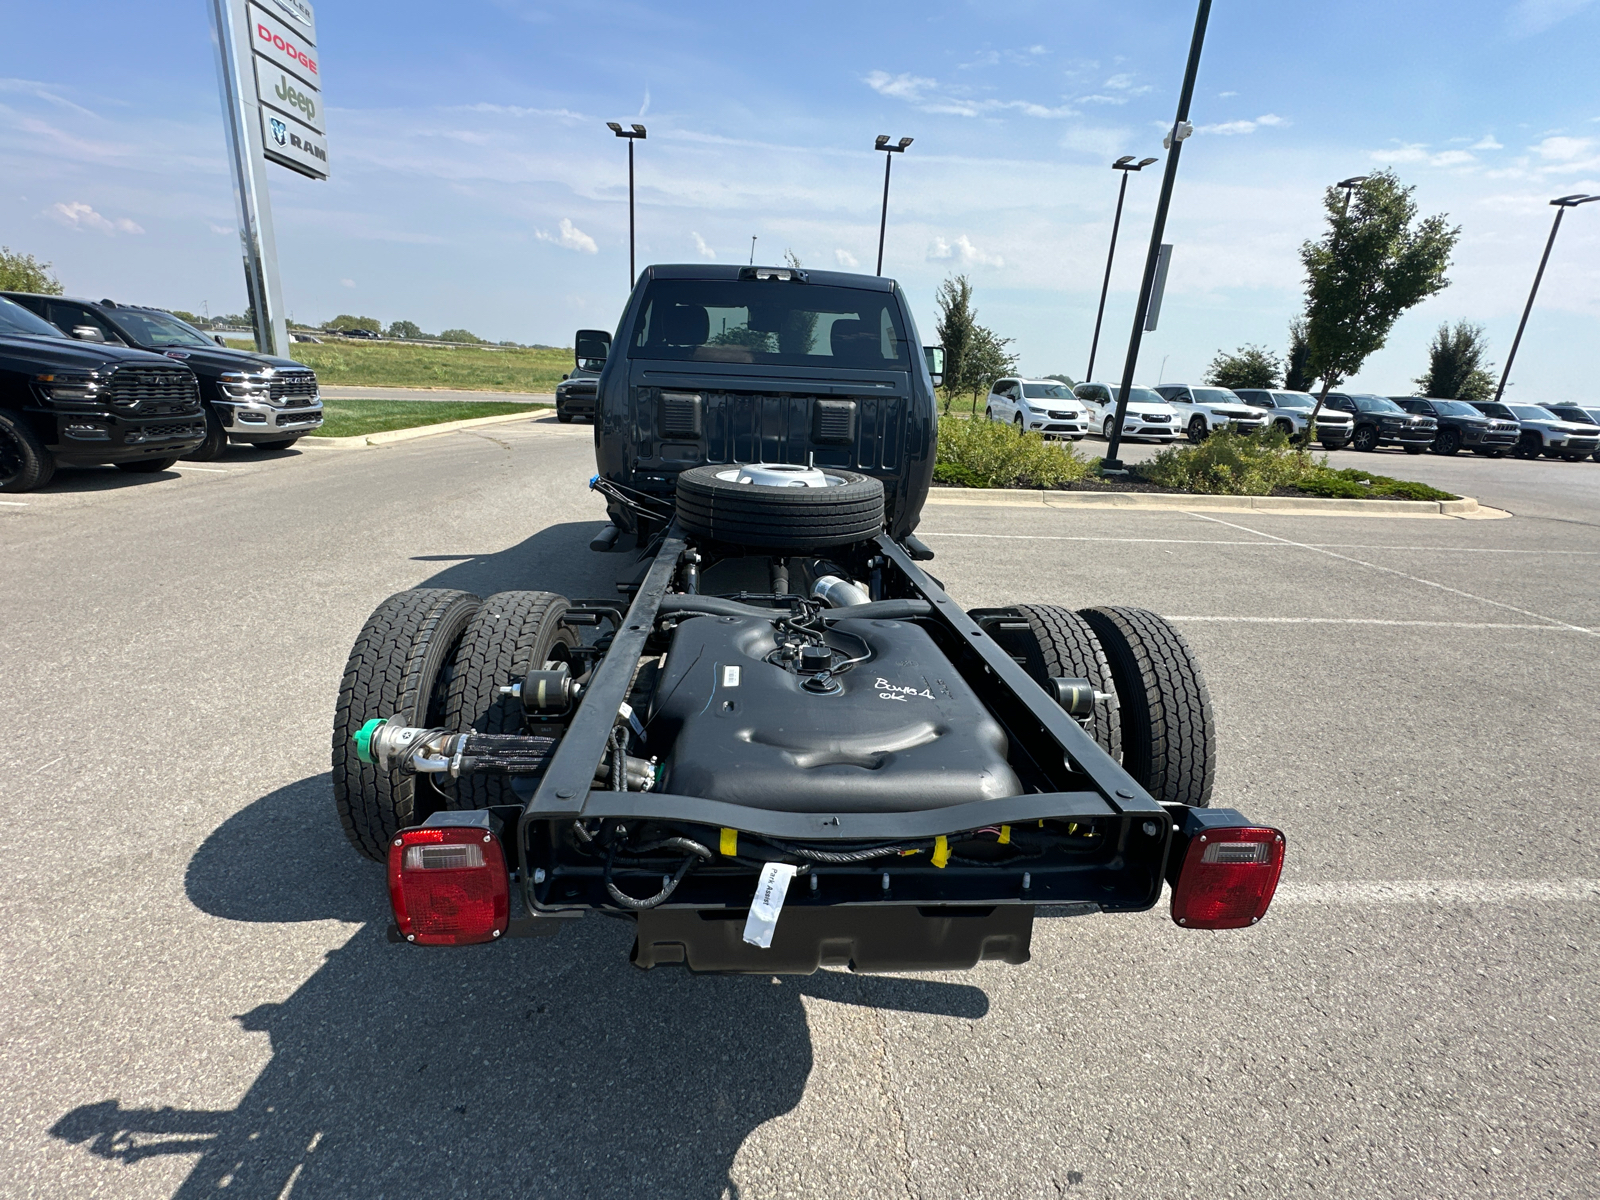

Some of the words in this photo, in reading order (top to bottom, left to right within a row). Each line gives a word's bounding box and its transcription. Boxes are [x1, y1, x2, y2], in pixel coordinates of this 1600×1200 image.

[257, 23, 318, 75] DODGE
[275, 74, 316, 121] Jeep
[290, 132, 327, 162] RAM
[139, 375, 182, 385] RAM
[768, 867, 778, 885] Park
[763, 885, 774, 906] Assist
